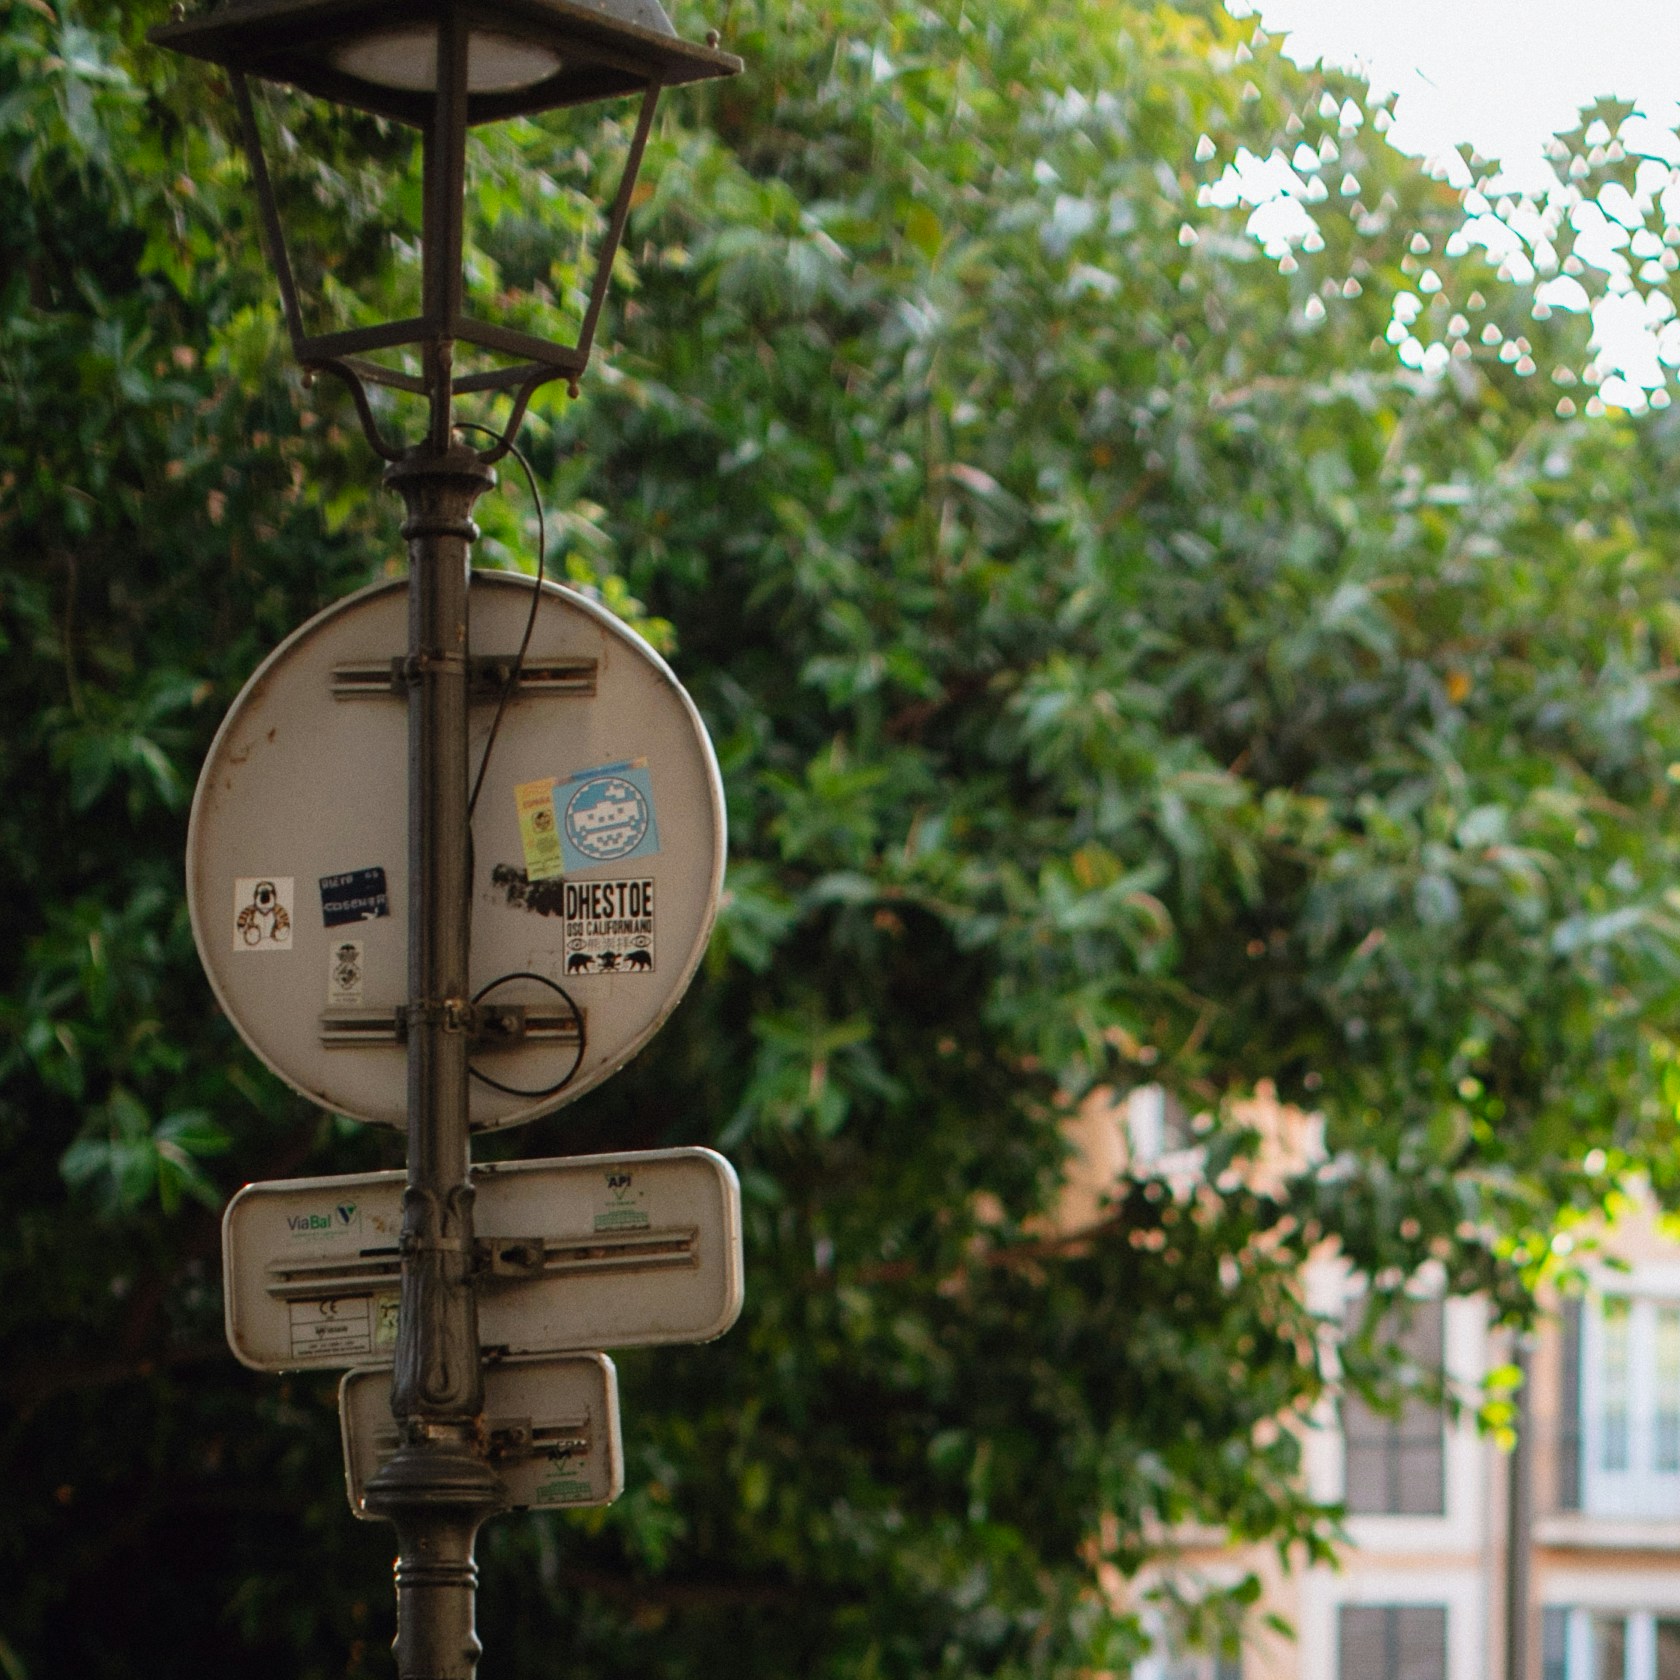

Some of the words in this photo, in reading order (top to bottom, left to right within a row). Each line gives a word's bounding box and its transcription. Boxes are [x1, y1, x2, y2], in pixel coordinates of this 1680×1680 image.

[566, 881, 653, 921] DHESTOE
[567, 921, 584, 937] OSO
[586, 918, 653, 936] CALIFORNIANO
[607, 1175, 632, 1189] API
[287, 1213, 332, 1231] ViaBal
